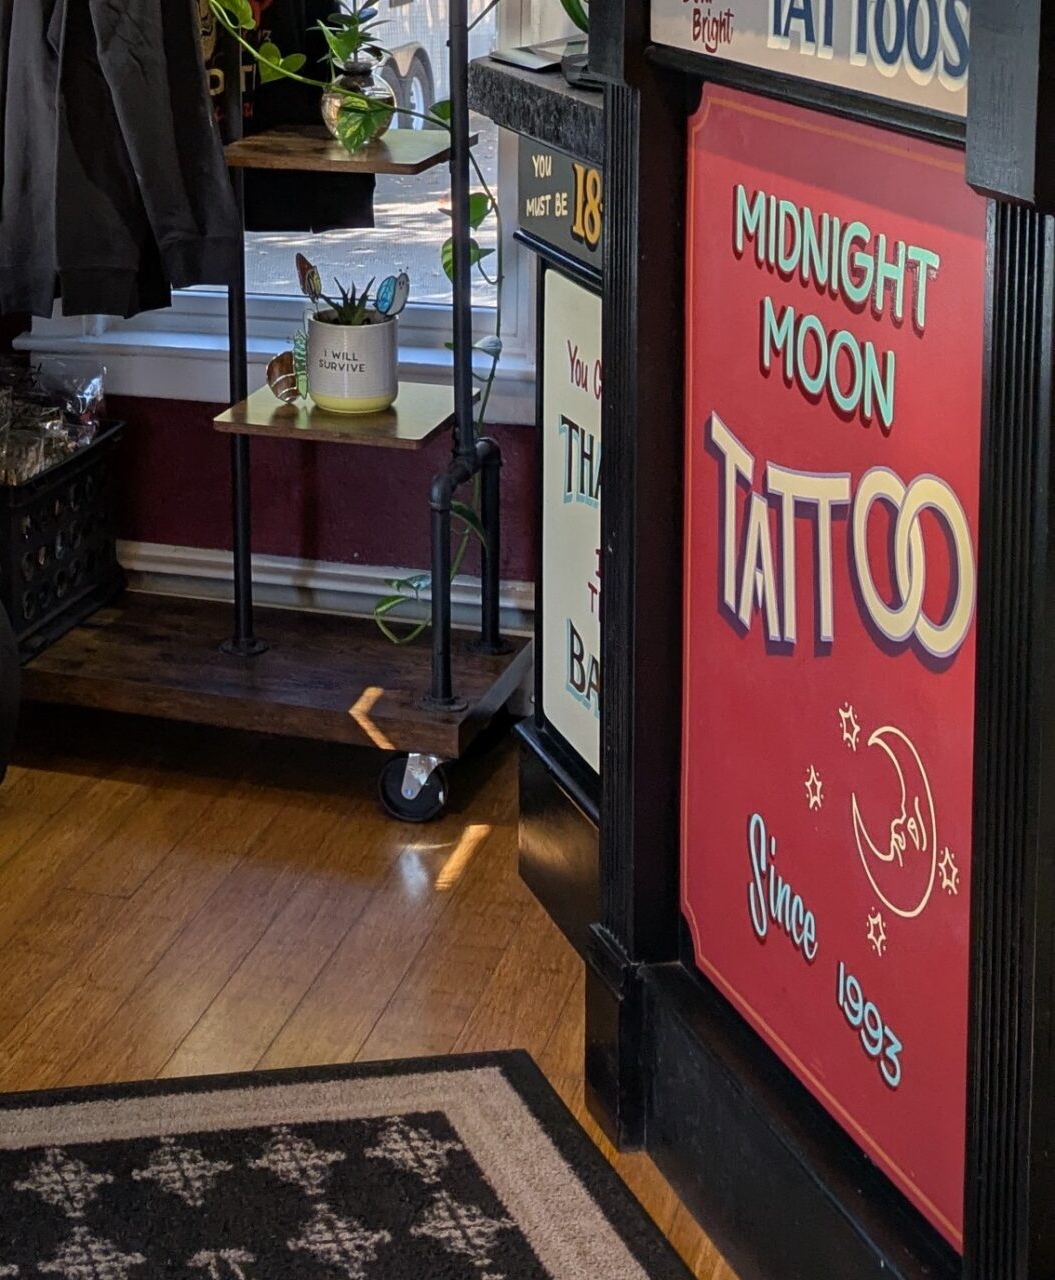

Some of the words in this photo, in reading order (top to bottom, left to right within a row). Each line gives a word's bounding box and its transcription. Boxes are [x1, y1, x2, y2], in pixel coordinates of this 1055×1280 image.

[692, 6, 735, 54] Bright
[532, 154, 552, 178] YOU
[526, 194, 551, 217] MUST
[555, 192, 568, 217] BE
[733, 183, 940, 331] MIDNIGHT
[318, 359, 366, 373] SURVIVE
[332, 351, 358, 362] WILL
[567, 339, 588, 393] You
[761, 295, 895, 429] MOON
[707, 410, 976, 659] TATTOO
[748, 813, 818, 962] Since
[835, 960, 904, 1089] 1993
